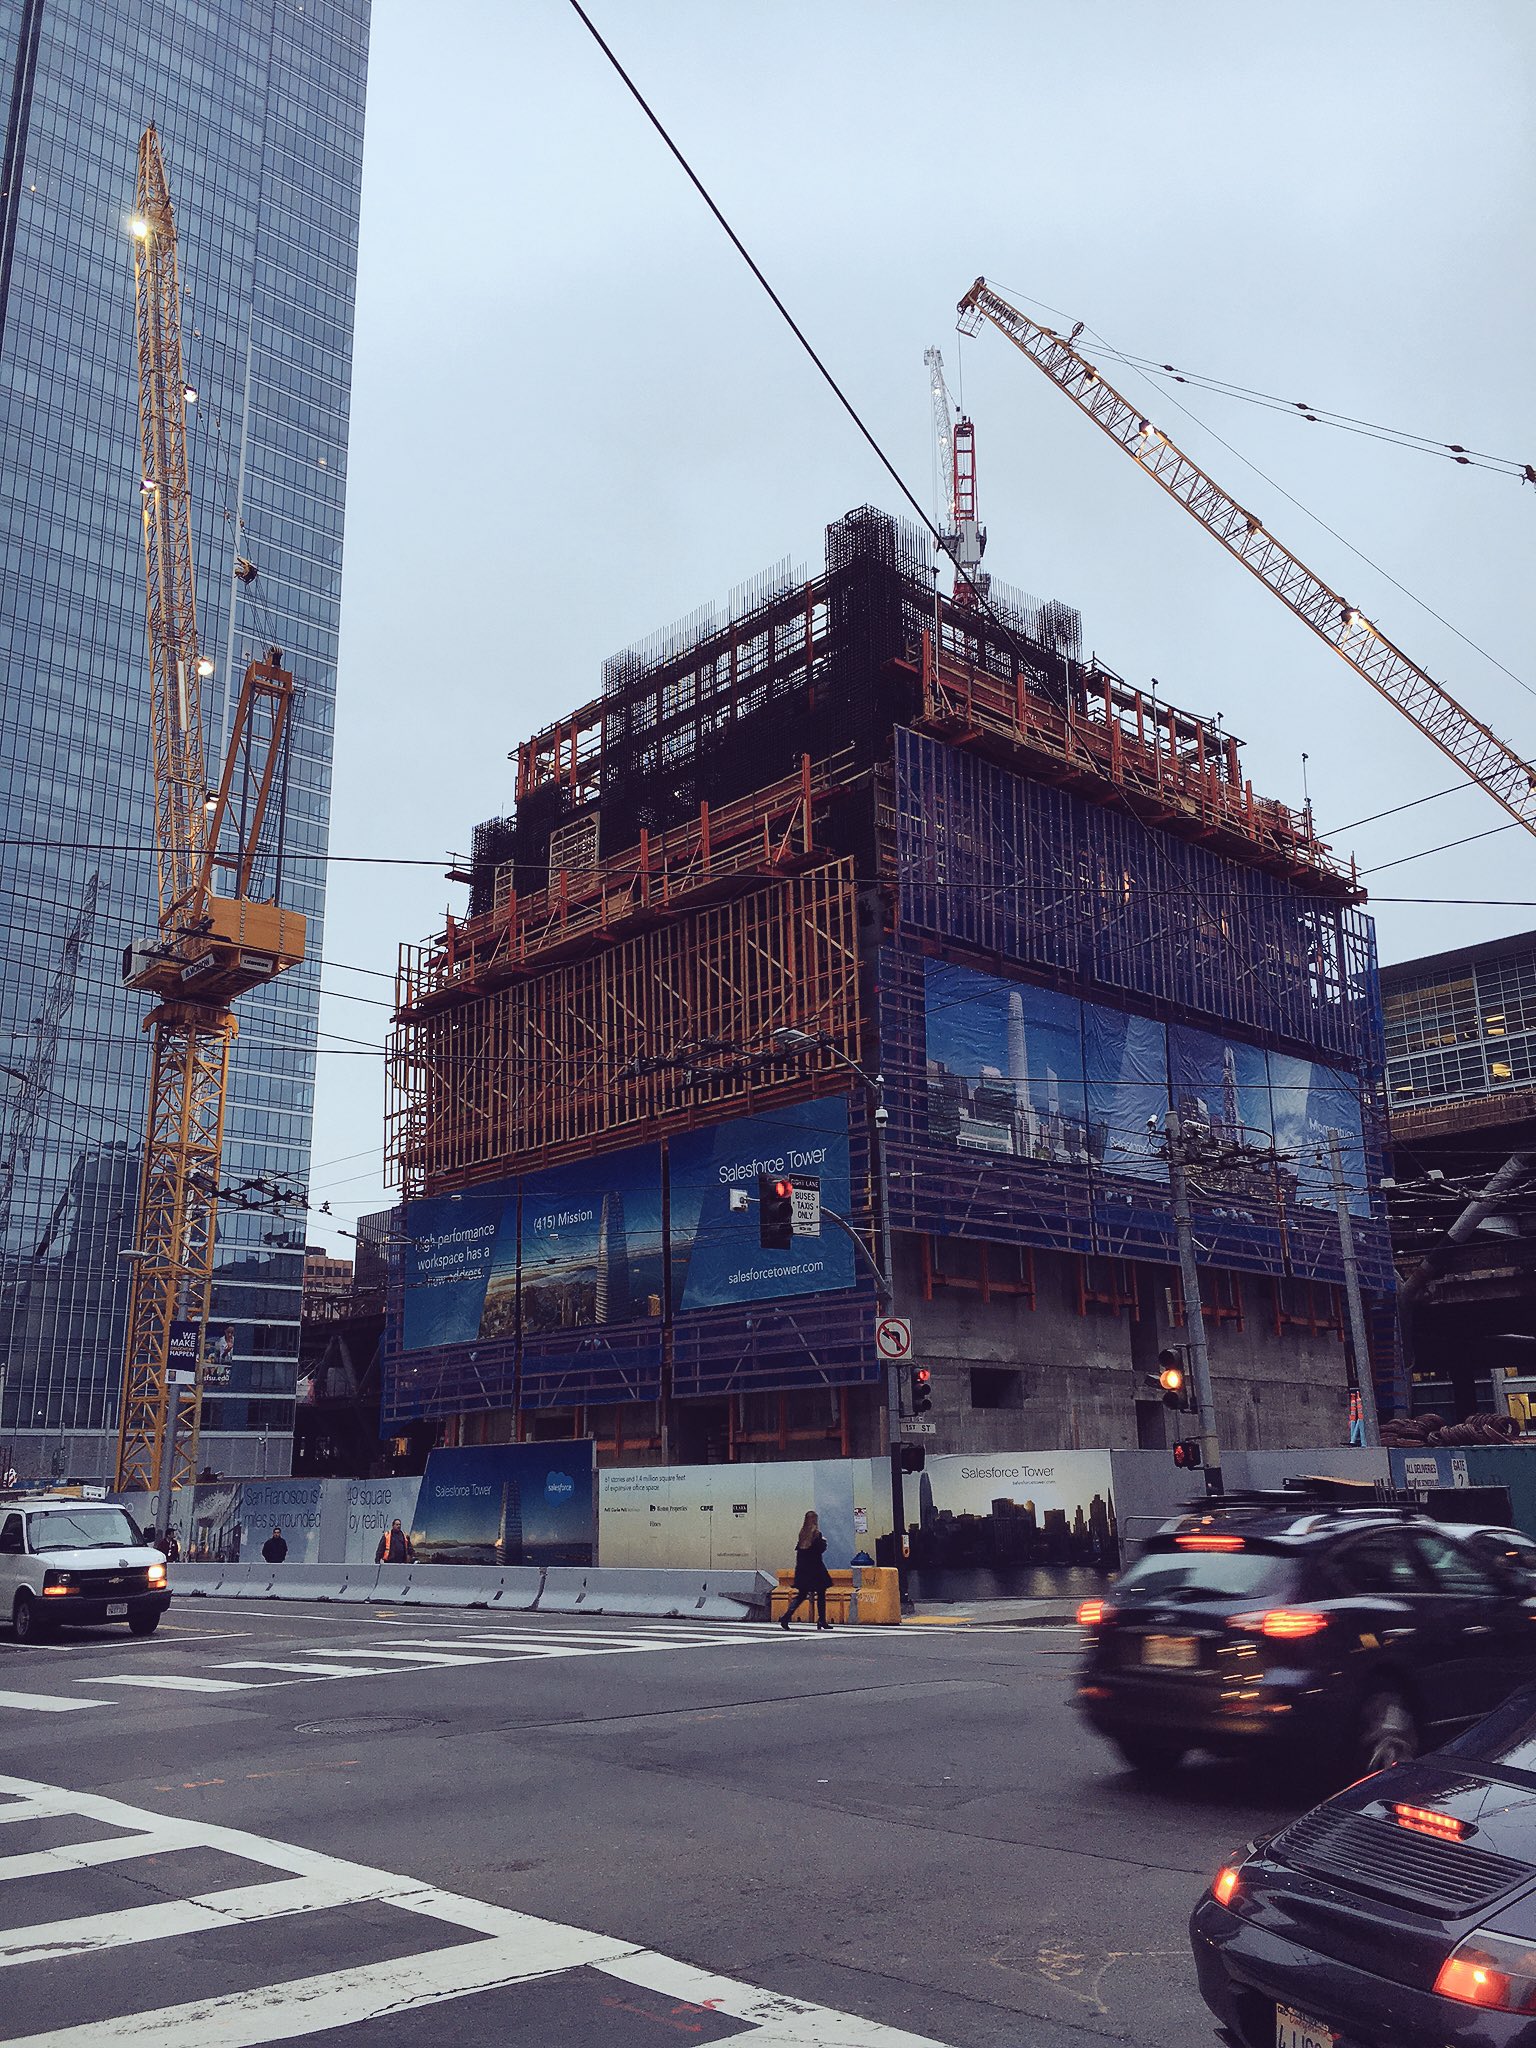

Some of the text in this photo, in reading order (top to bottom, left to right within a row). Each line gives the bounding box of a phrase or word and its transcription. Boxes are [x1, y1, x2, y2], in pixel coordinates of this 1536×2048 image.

[719, 1147, 827, 1183] Salesforce Tower
[794, 1191, 816, 1202] BUSES
[797, 1201, 814, 1211] TAXIS
[533, 1209, 593, 1233] (415) Mission
[797, 1210, 813, 1220] ONLY
[437, 1224, 495, 1249] performance
[417, 1246, 490, 1270] workspace has a
[728, 1261, 824, 1284] salesforcetower.com
[182, 1331, 197, 1340] WE
[170, 1338, 196, 1348] MAKE
[169, 1350, 195, 1358] HAPPEN
[961, 1465, 1055, 1479] Salesforce Tower
[1453, 1460, 1466, 1471] GATE
[435, 1483, 491, 1497] Salesforce Tower
[548, 1483, 572, 1492] salesforce
[246, 1486, 319, 1506] San Francisco is
[360, 1488, 392, 1509] square
[244, 1510, 321, 1528] miles surrounded
[349, 1511, 361, 1533] by
